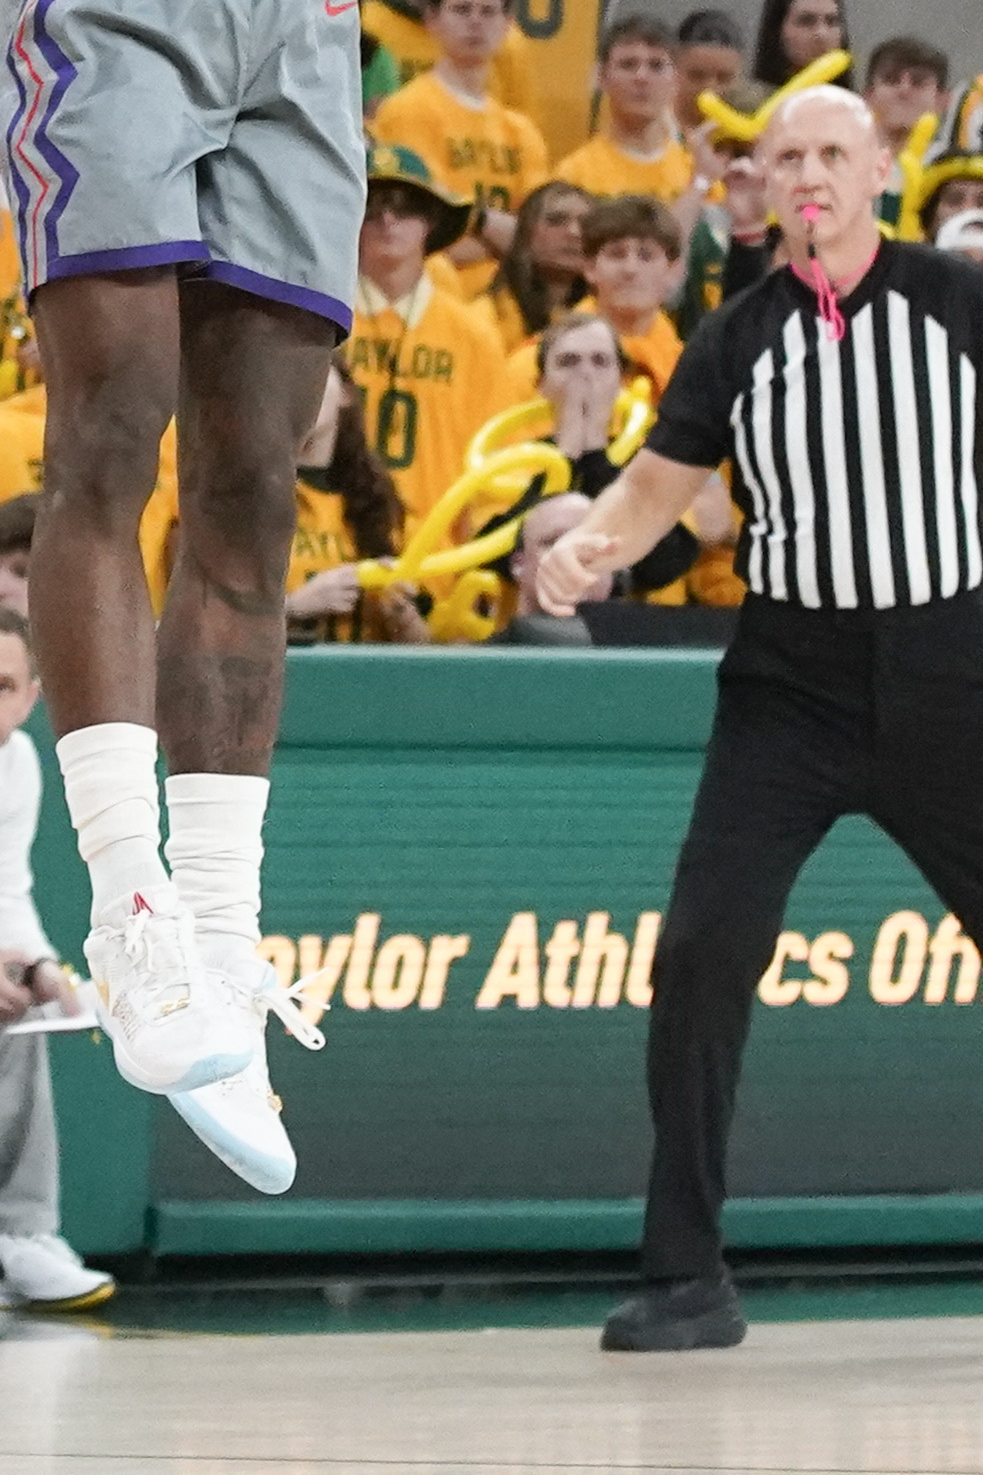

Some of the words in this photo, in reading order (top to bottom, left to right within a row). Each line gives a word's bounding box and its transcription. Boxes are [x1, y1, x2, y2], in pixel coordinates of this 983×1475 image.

[350, 336, 454, 384] AYLOR
[255, 911, 471, 1034] aylor
[474, 911, 855, 1007] Athlcs
